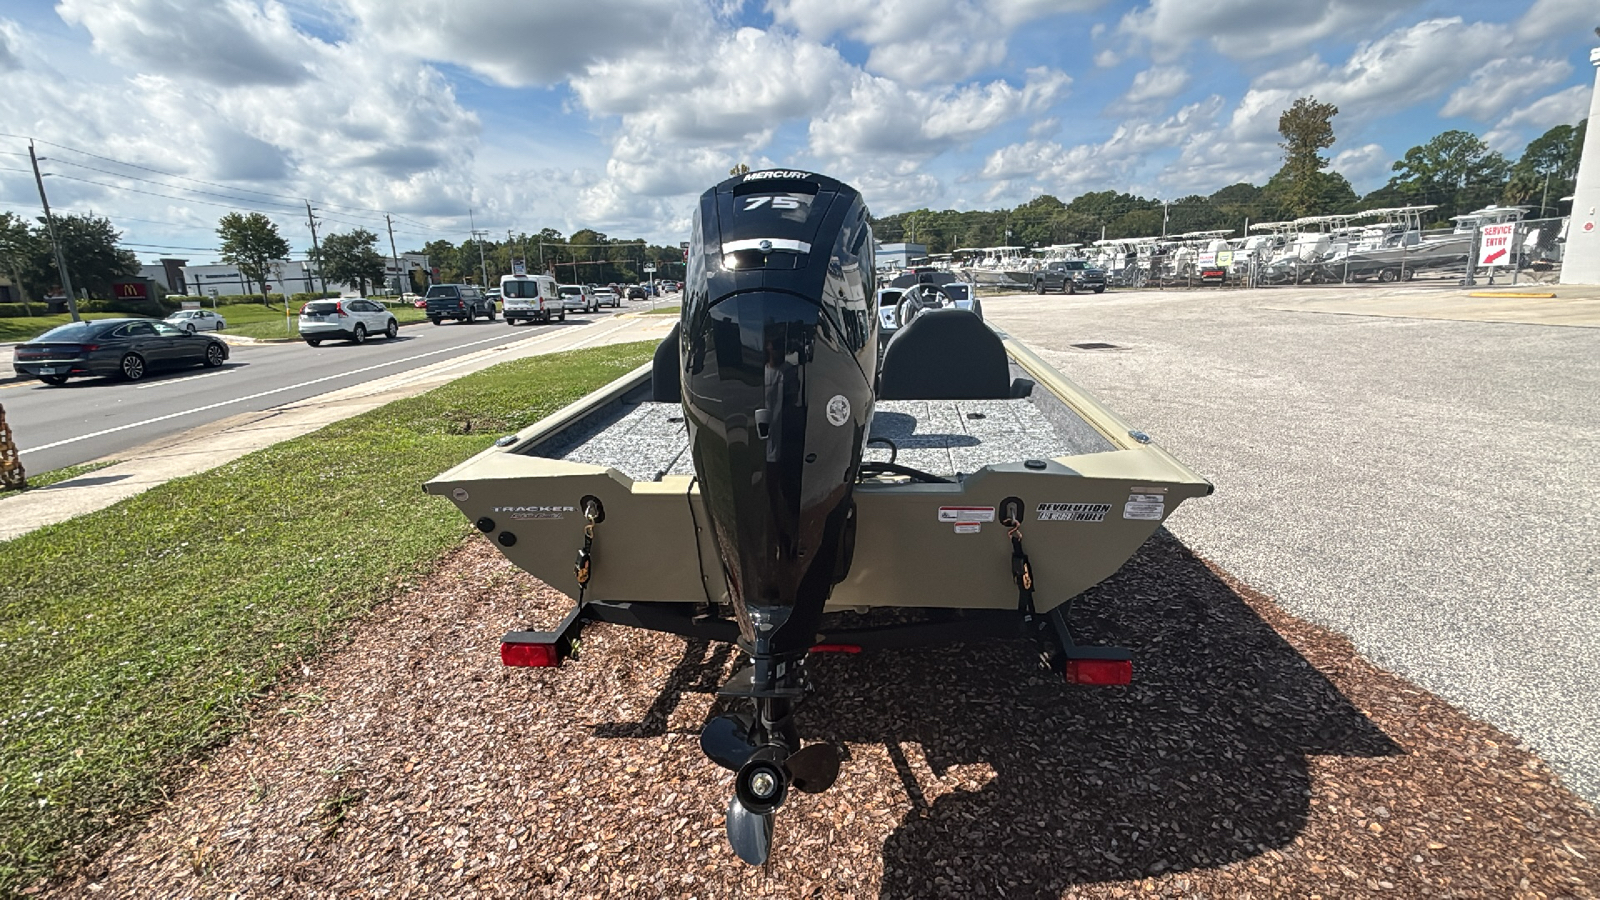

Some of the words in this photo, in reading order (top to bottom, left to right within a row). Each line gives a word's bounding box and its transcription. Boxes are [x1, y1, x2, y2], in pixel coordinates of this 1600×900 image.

[743, 171, 812, 182] MERCURY
[743, 196, 799, 211] 75
[1484, 225, 1512, 236] SERVICE
[1486, 237, 1507, 247] ENTRY
[1038, 504, 1111, 512] REVOLUTION
